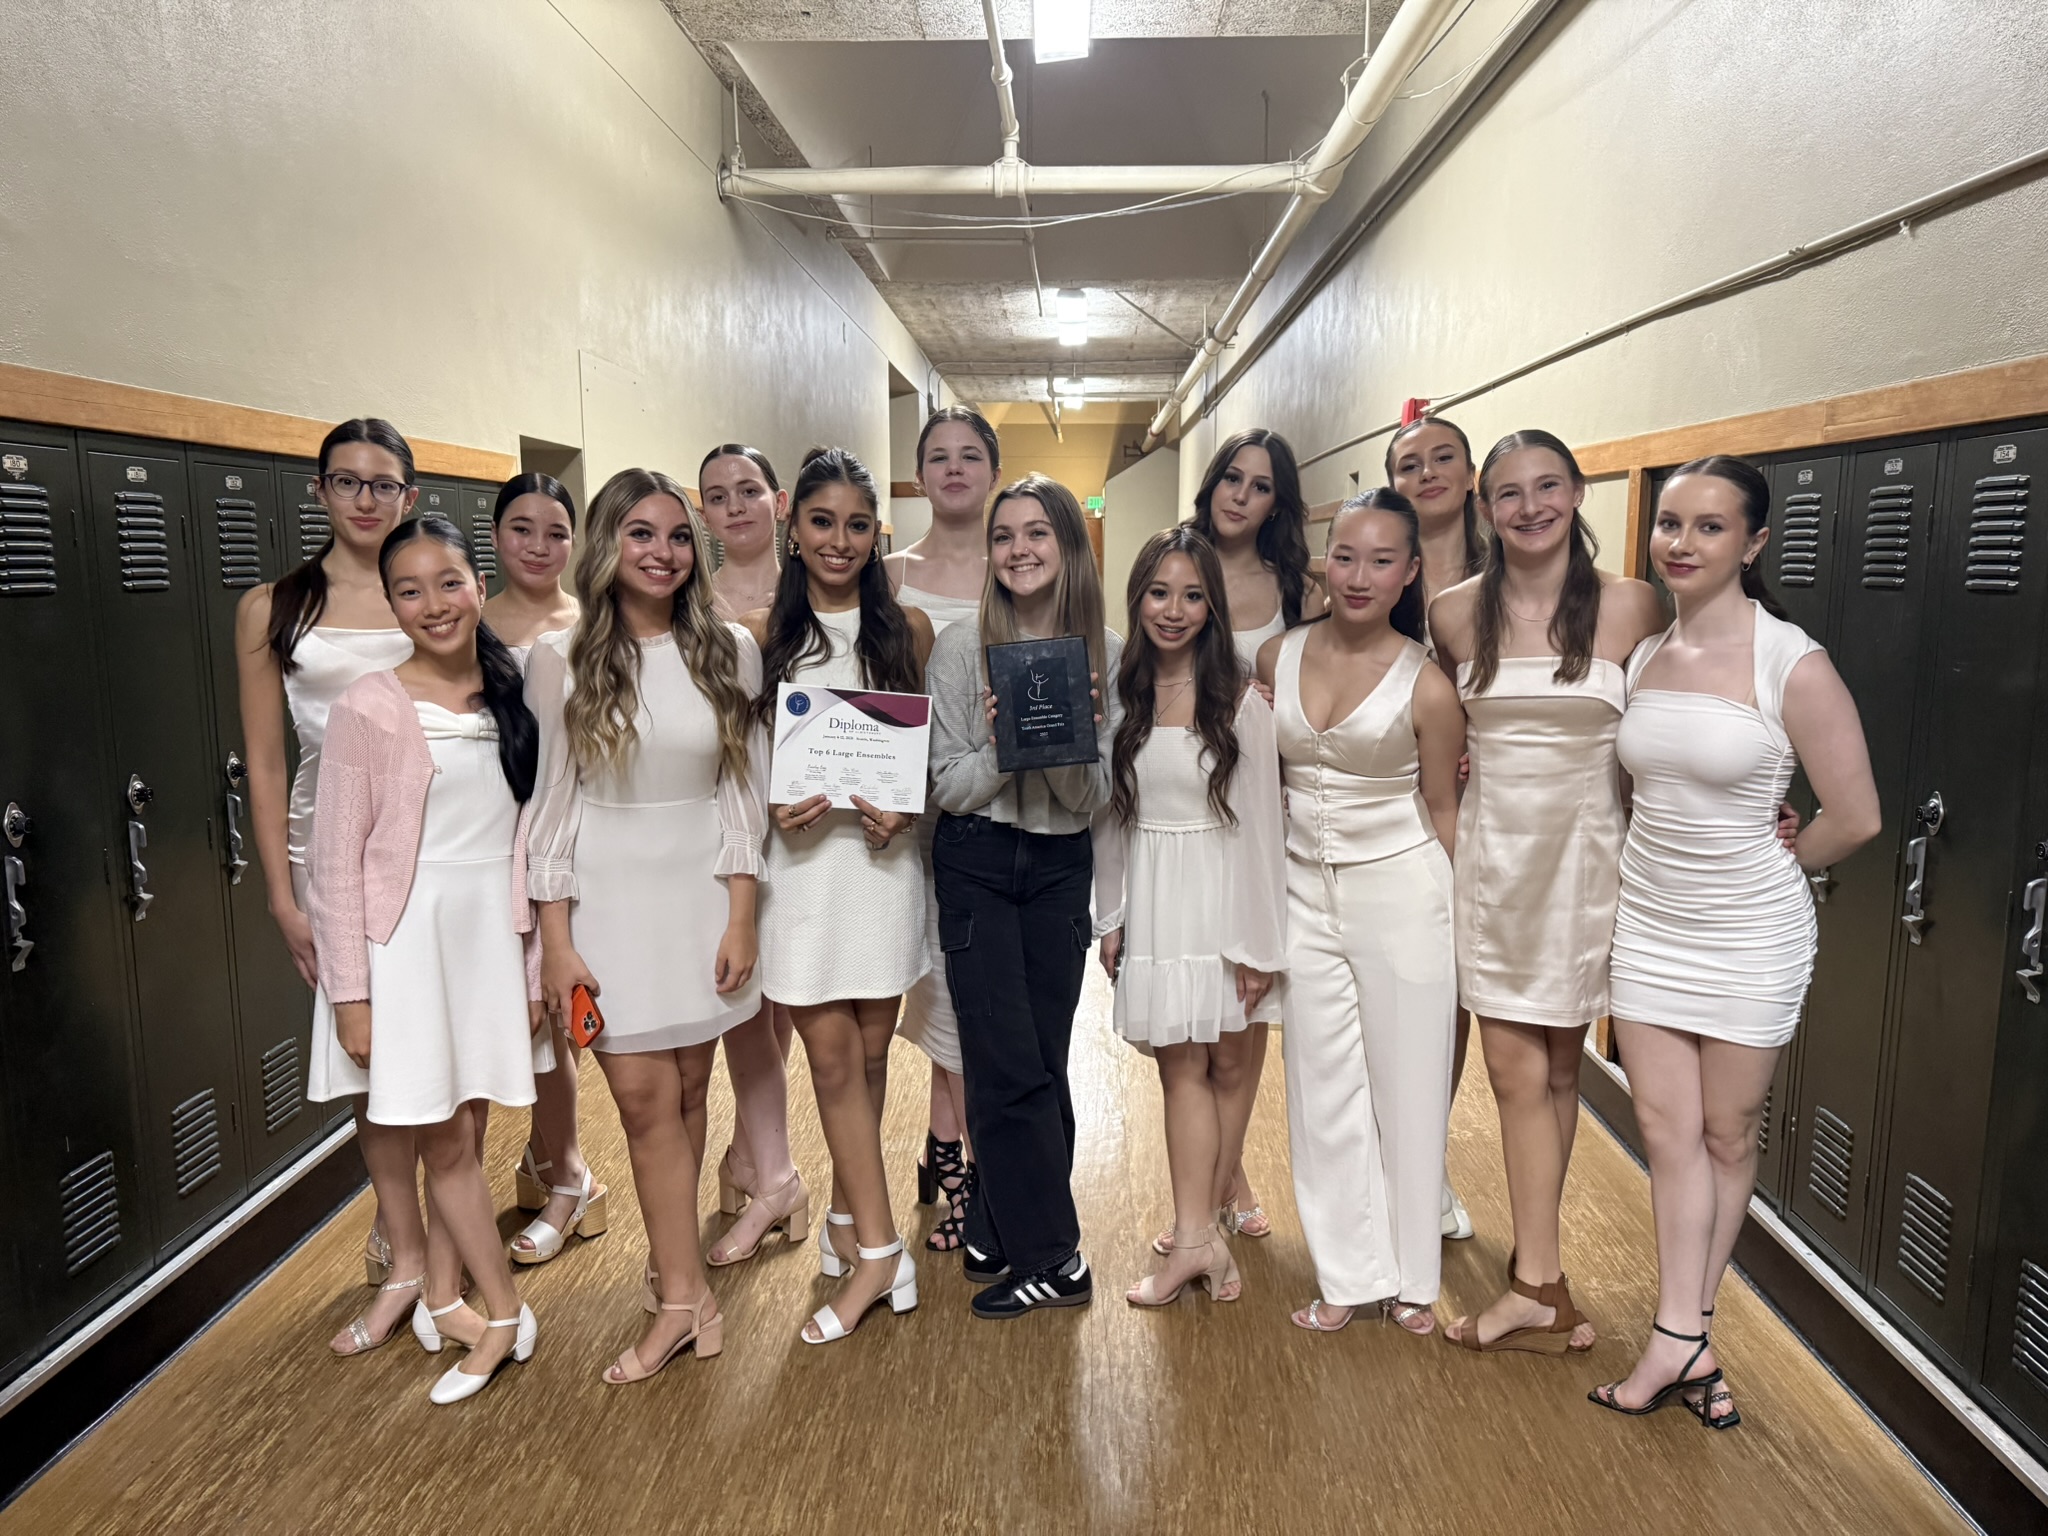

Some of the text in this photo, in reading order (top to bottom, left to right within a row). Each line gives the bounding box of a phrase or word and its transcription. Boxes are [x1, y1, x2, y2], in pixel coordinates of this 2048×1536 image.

[829, 717, 879, 733] Diploma
[808, 747, 824, 756] Top
[832, 749, 854, 758] Large
[856, 751, 896, 760] Ensembles
